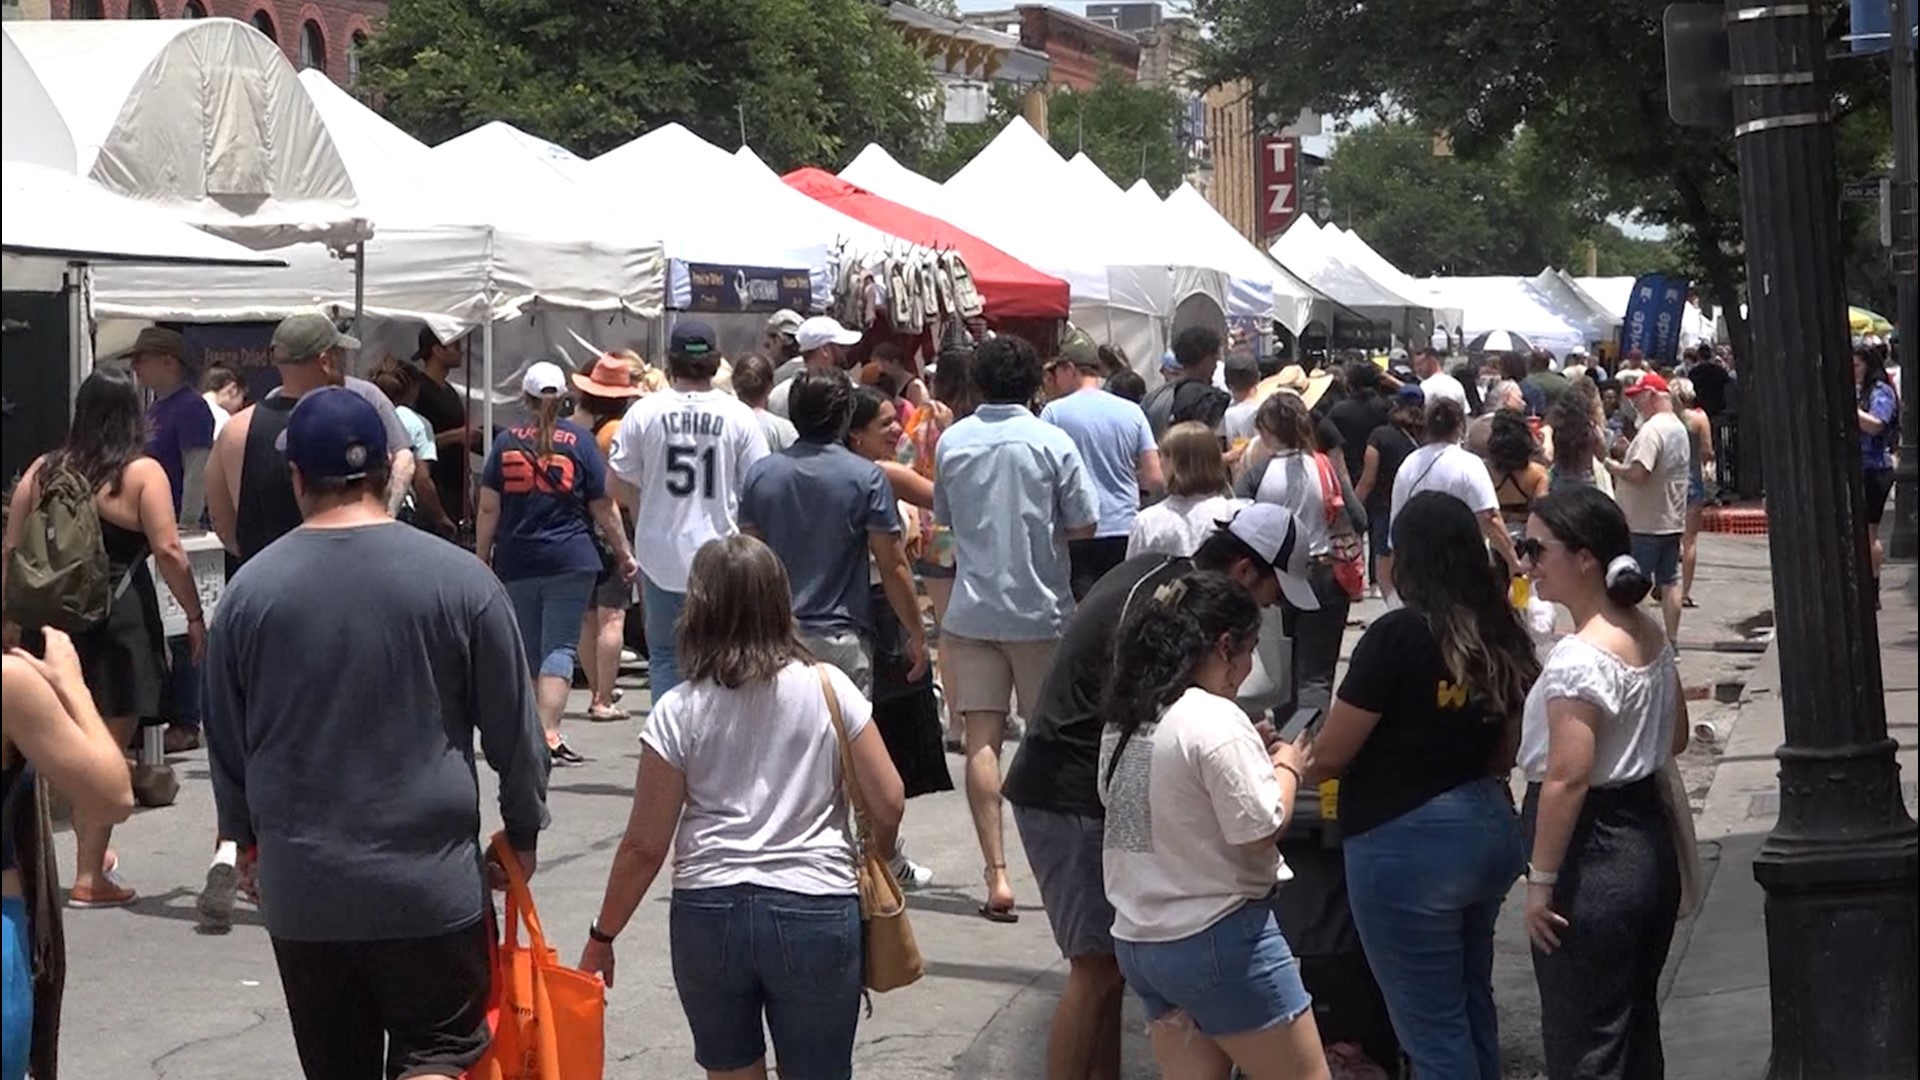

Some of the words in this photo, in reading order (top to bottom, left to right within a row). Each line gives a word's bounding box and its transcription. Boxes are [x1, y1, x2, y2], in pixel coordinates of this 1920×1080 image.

[661, 411, 724, 437] ICHIRO
[501, 450, 575, 493] 30
[665, 445, 716, 499] 51
